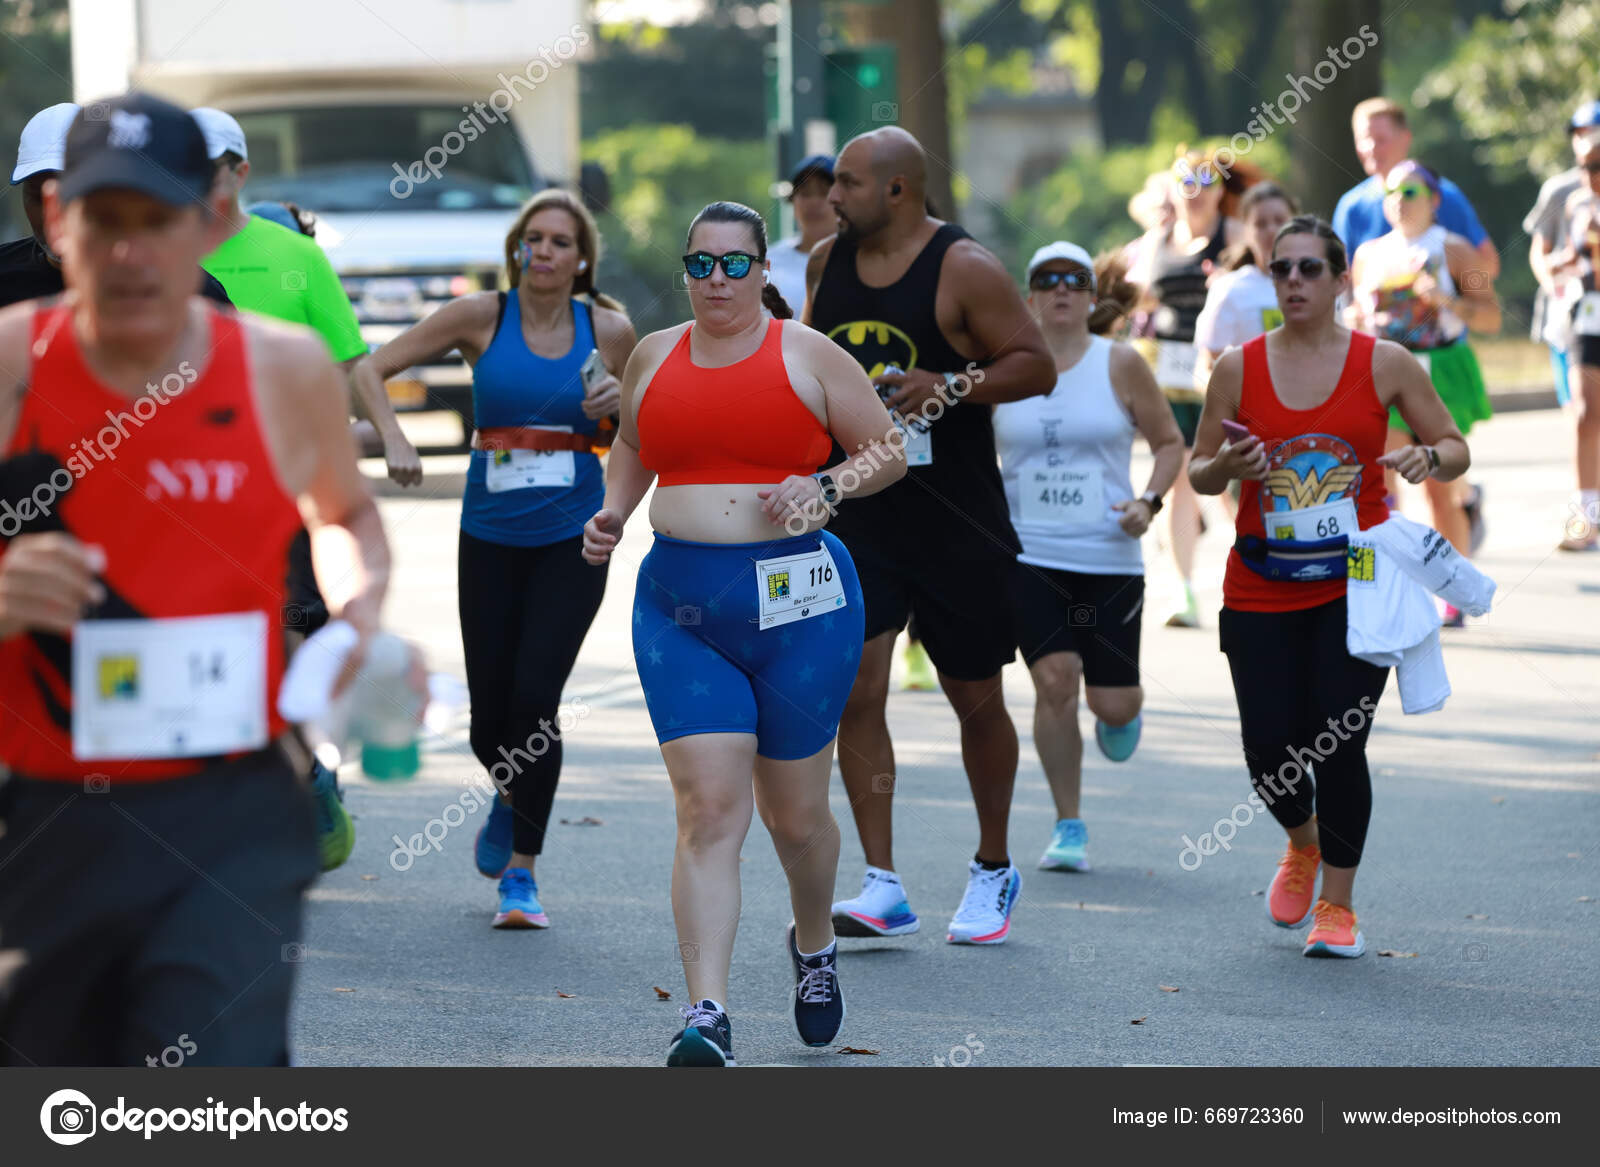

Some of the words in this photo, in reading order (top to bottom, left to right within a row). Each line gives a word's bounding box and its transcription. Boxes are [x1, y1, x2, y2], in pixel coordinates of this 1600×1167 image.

[1040, 488, 1083, 506] 4166
[1317, 516, 1340, 538] 68
[809, 562, 833, 588] 116
